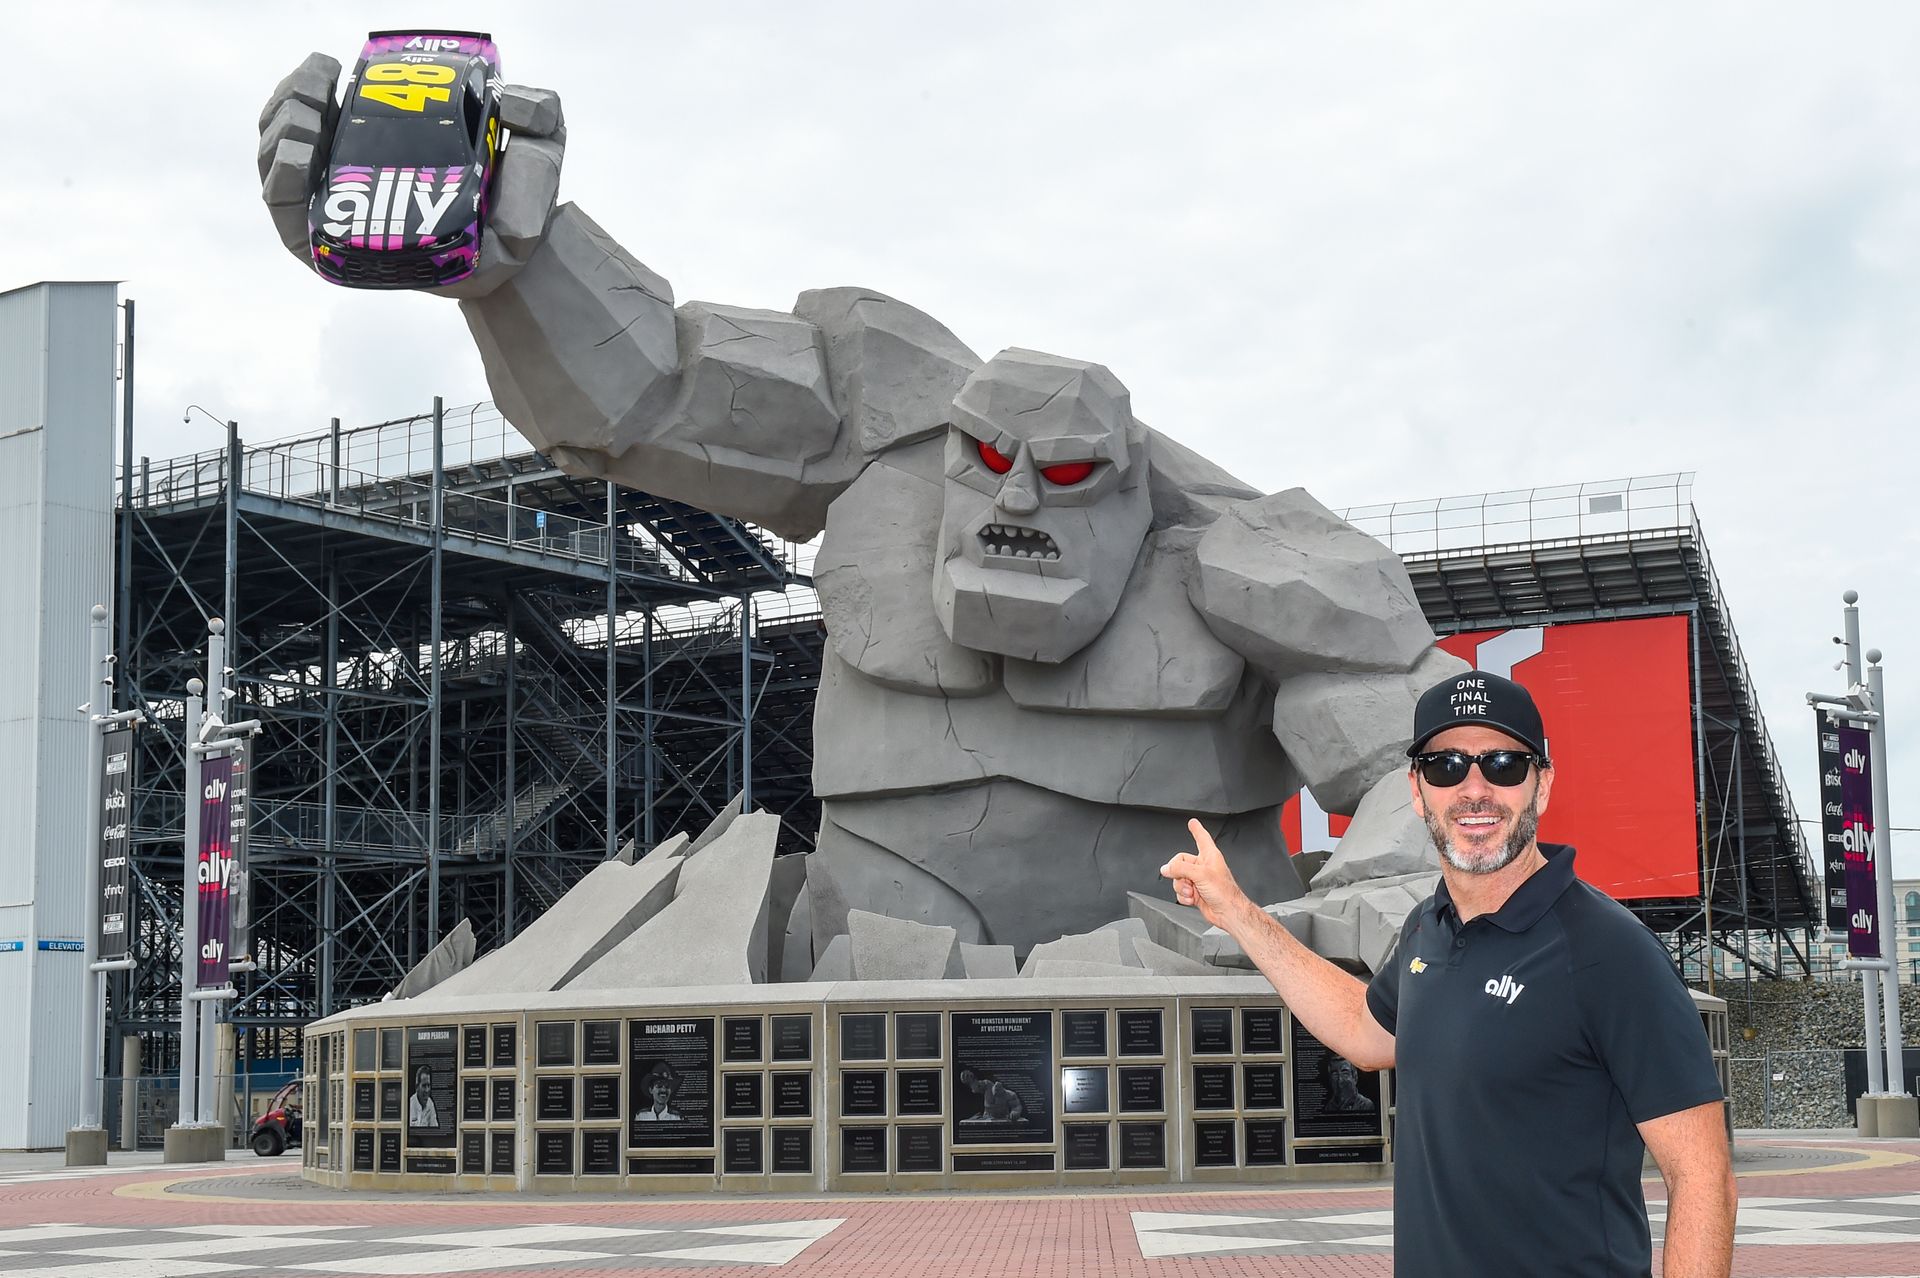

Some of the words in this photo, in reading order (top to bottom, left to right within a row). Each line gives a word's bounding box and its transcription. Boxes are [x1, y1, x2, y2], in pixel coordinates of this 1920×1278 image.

[404, 36, 460, 51] ally
[359, 63, 456, 112] 48
[323, 171, 462, 238] ally
[319, 245, 330, 256] 48
[1457, 679, 1485, 690] ONE
[1450, 691, 1492, 705] FINAL
[1453, 704, 1487, 716] TIME
[1844, 748, 1866, 774] ally
[204, 778, 227, 802] ally
[231, 818, 246, 828] NSTER
[1827, 833, 1844, 843] GEIC
[1842, 822, 1875, 862] ally
[104, 857, 126, 868] GEICO
[1829, 858, 1845, 873] xfini
[198, 851, 232, 890] ally
[1851, 908, 1873, 934] ally
[202, 938, 224, 963] ally
[1485, 975, 1525, 1005] ally
[645, 1024, 676, 1034] RICHARD
[676, 1023, 697, 1033] PETTY
